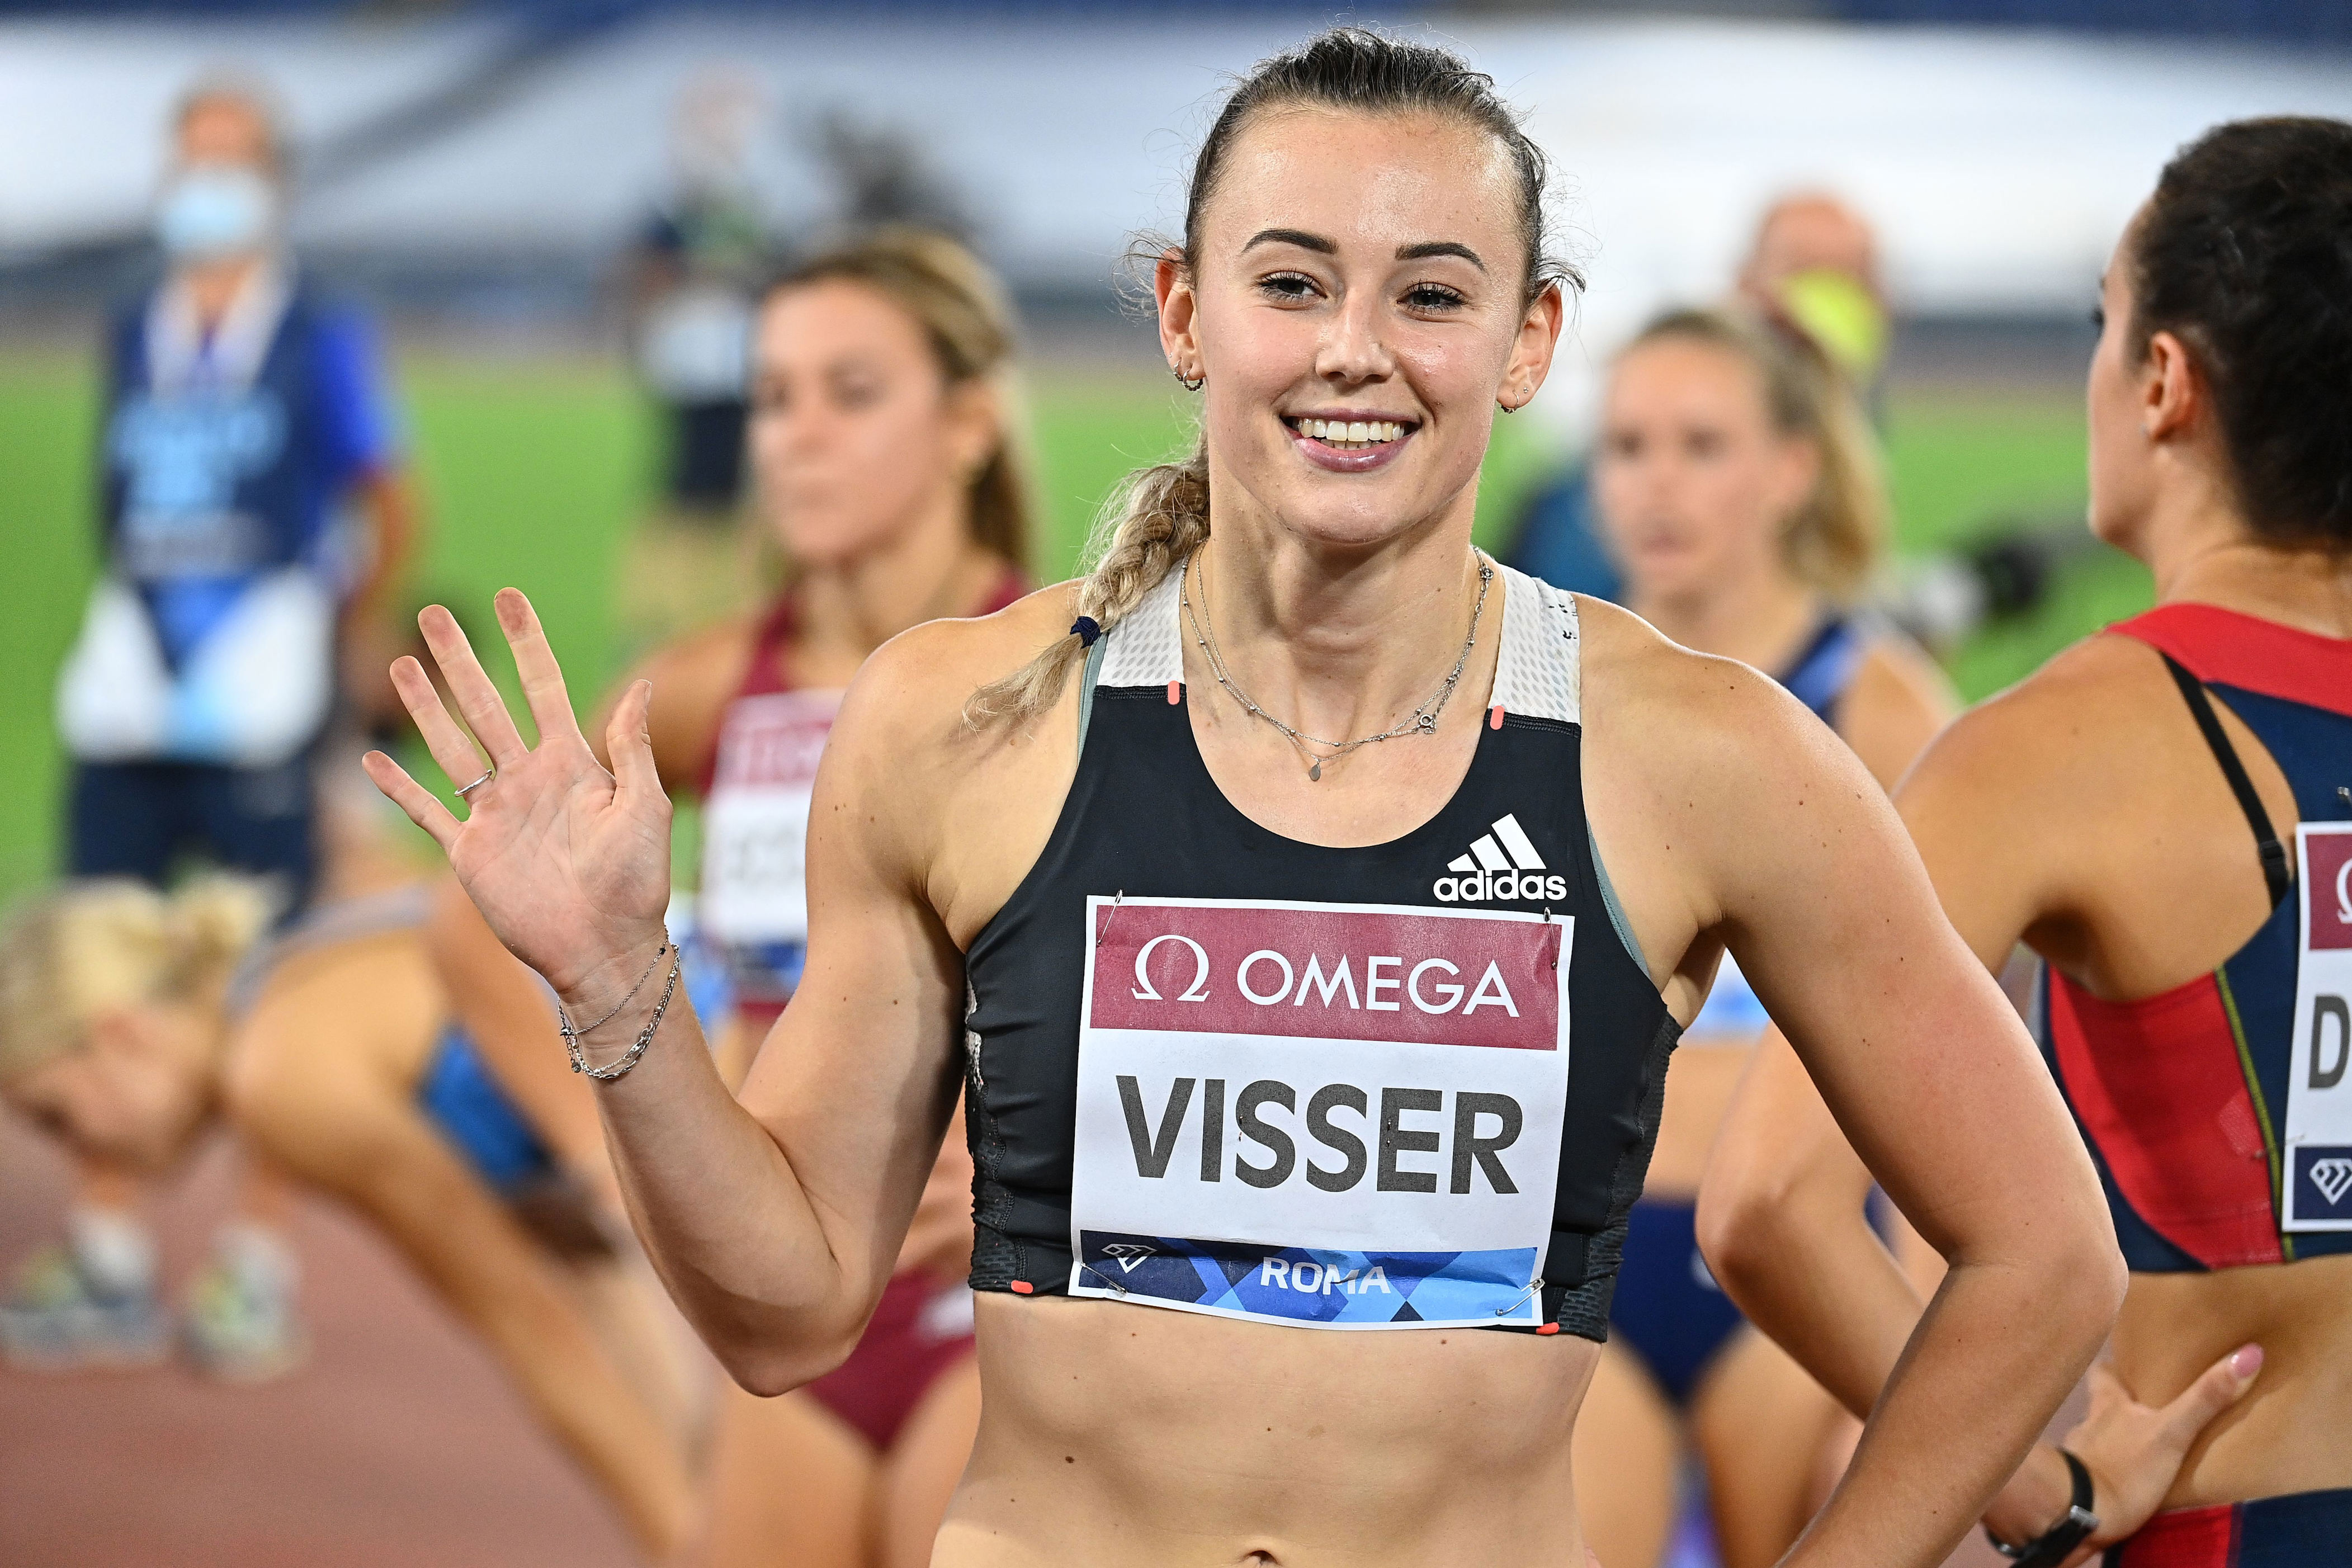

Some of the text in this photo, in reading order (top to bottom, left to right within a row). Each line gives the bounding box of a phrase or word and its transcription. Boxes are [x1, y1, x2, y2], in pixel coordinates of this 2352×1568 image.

[1433, 868, 1566, 902] adidas
[1236, 949, 1520, 1018] OMEGA
[1115, 1074, 1523, 1195] VISSER
[1260, 1257, 1391, 1296] ROMA
